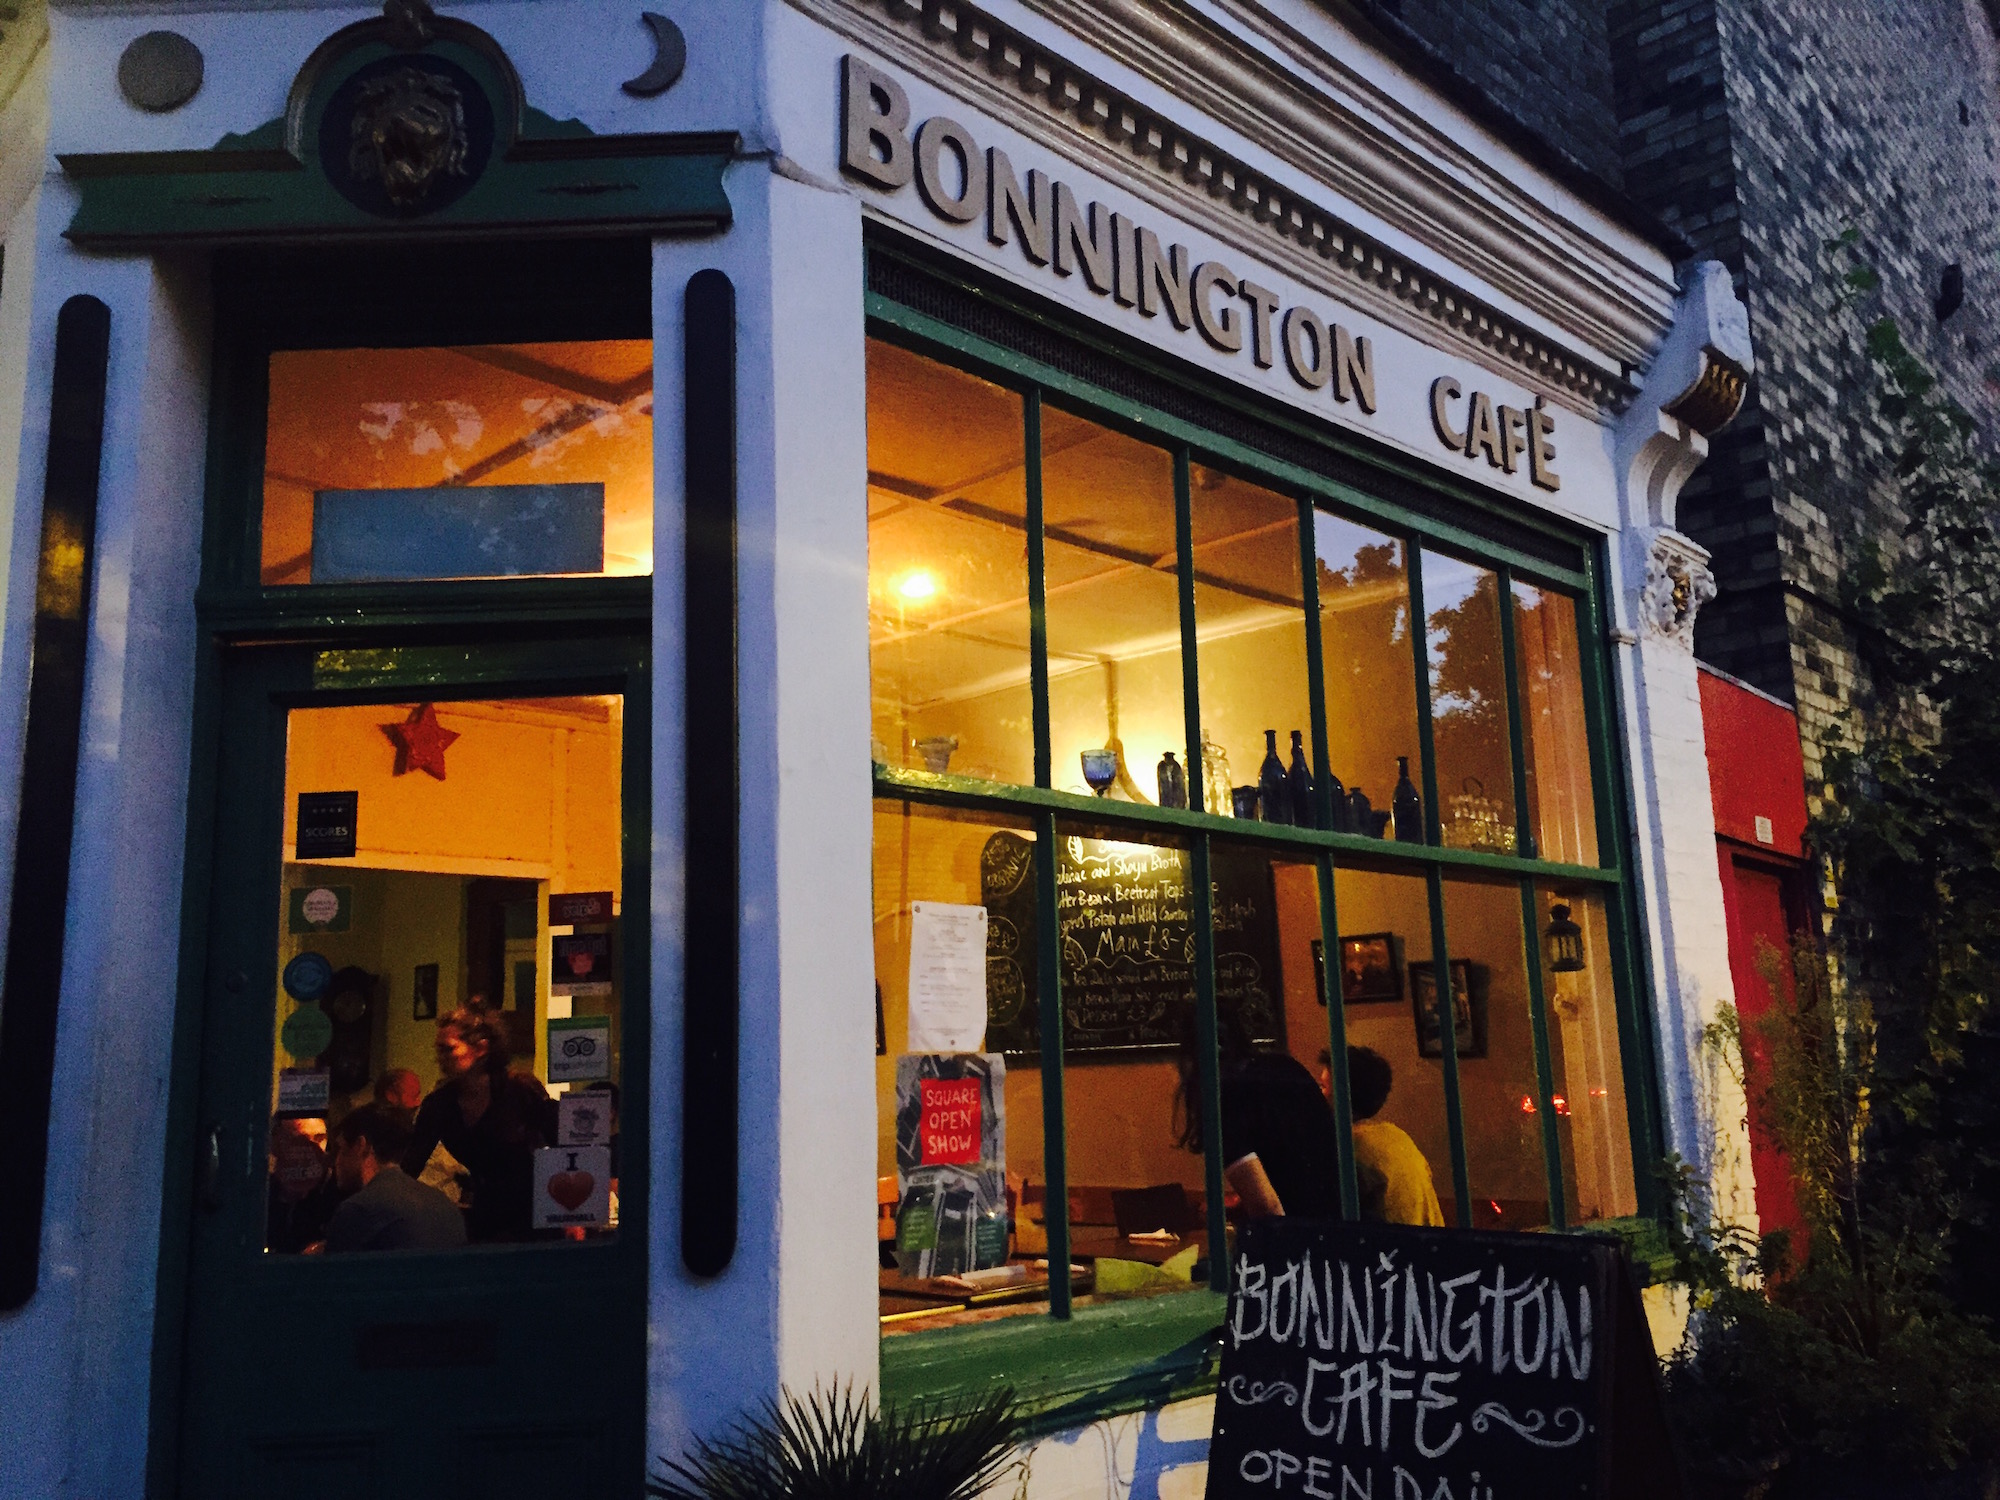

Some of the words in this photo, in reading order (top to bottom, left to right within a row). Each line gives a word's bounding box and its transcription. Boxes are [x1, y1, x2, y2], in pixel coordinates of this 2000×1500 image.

[839, 54, 1376, 415] BONNINGTON
[1429, 375, 1561, 492] CAFÉ
[1096, 928, 1140, 958] Main
[926, 1088, 977, 1107] SQUARE
[929, 1110, 972, 1131] OPEN
[928, 1134, 972, 1155] SHOW
[567, 1153, 578, 1171] I
[1302, 1356, 1463, 1459] CAFE
[1240, 1449, 1372, 1500] OPEN
